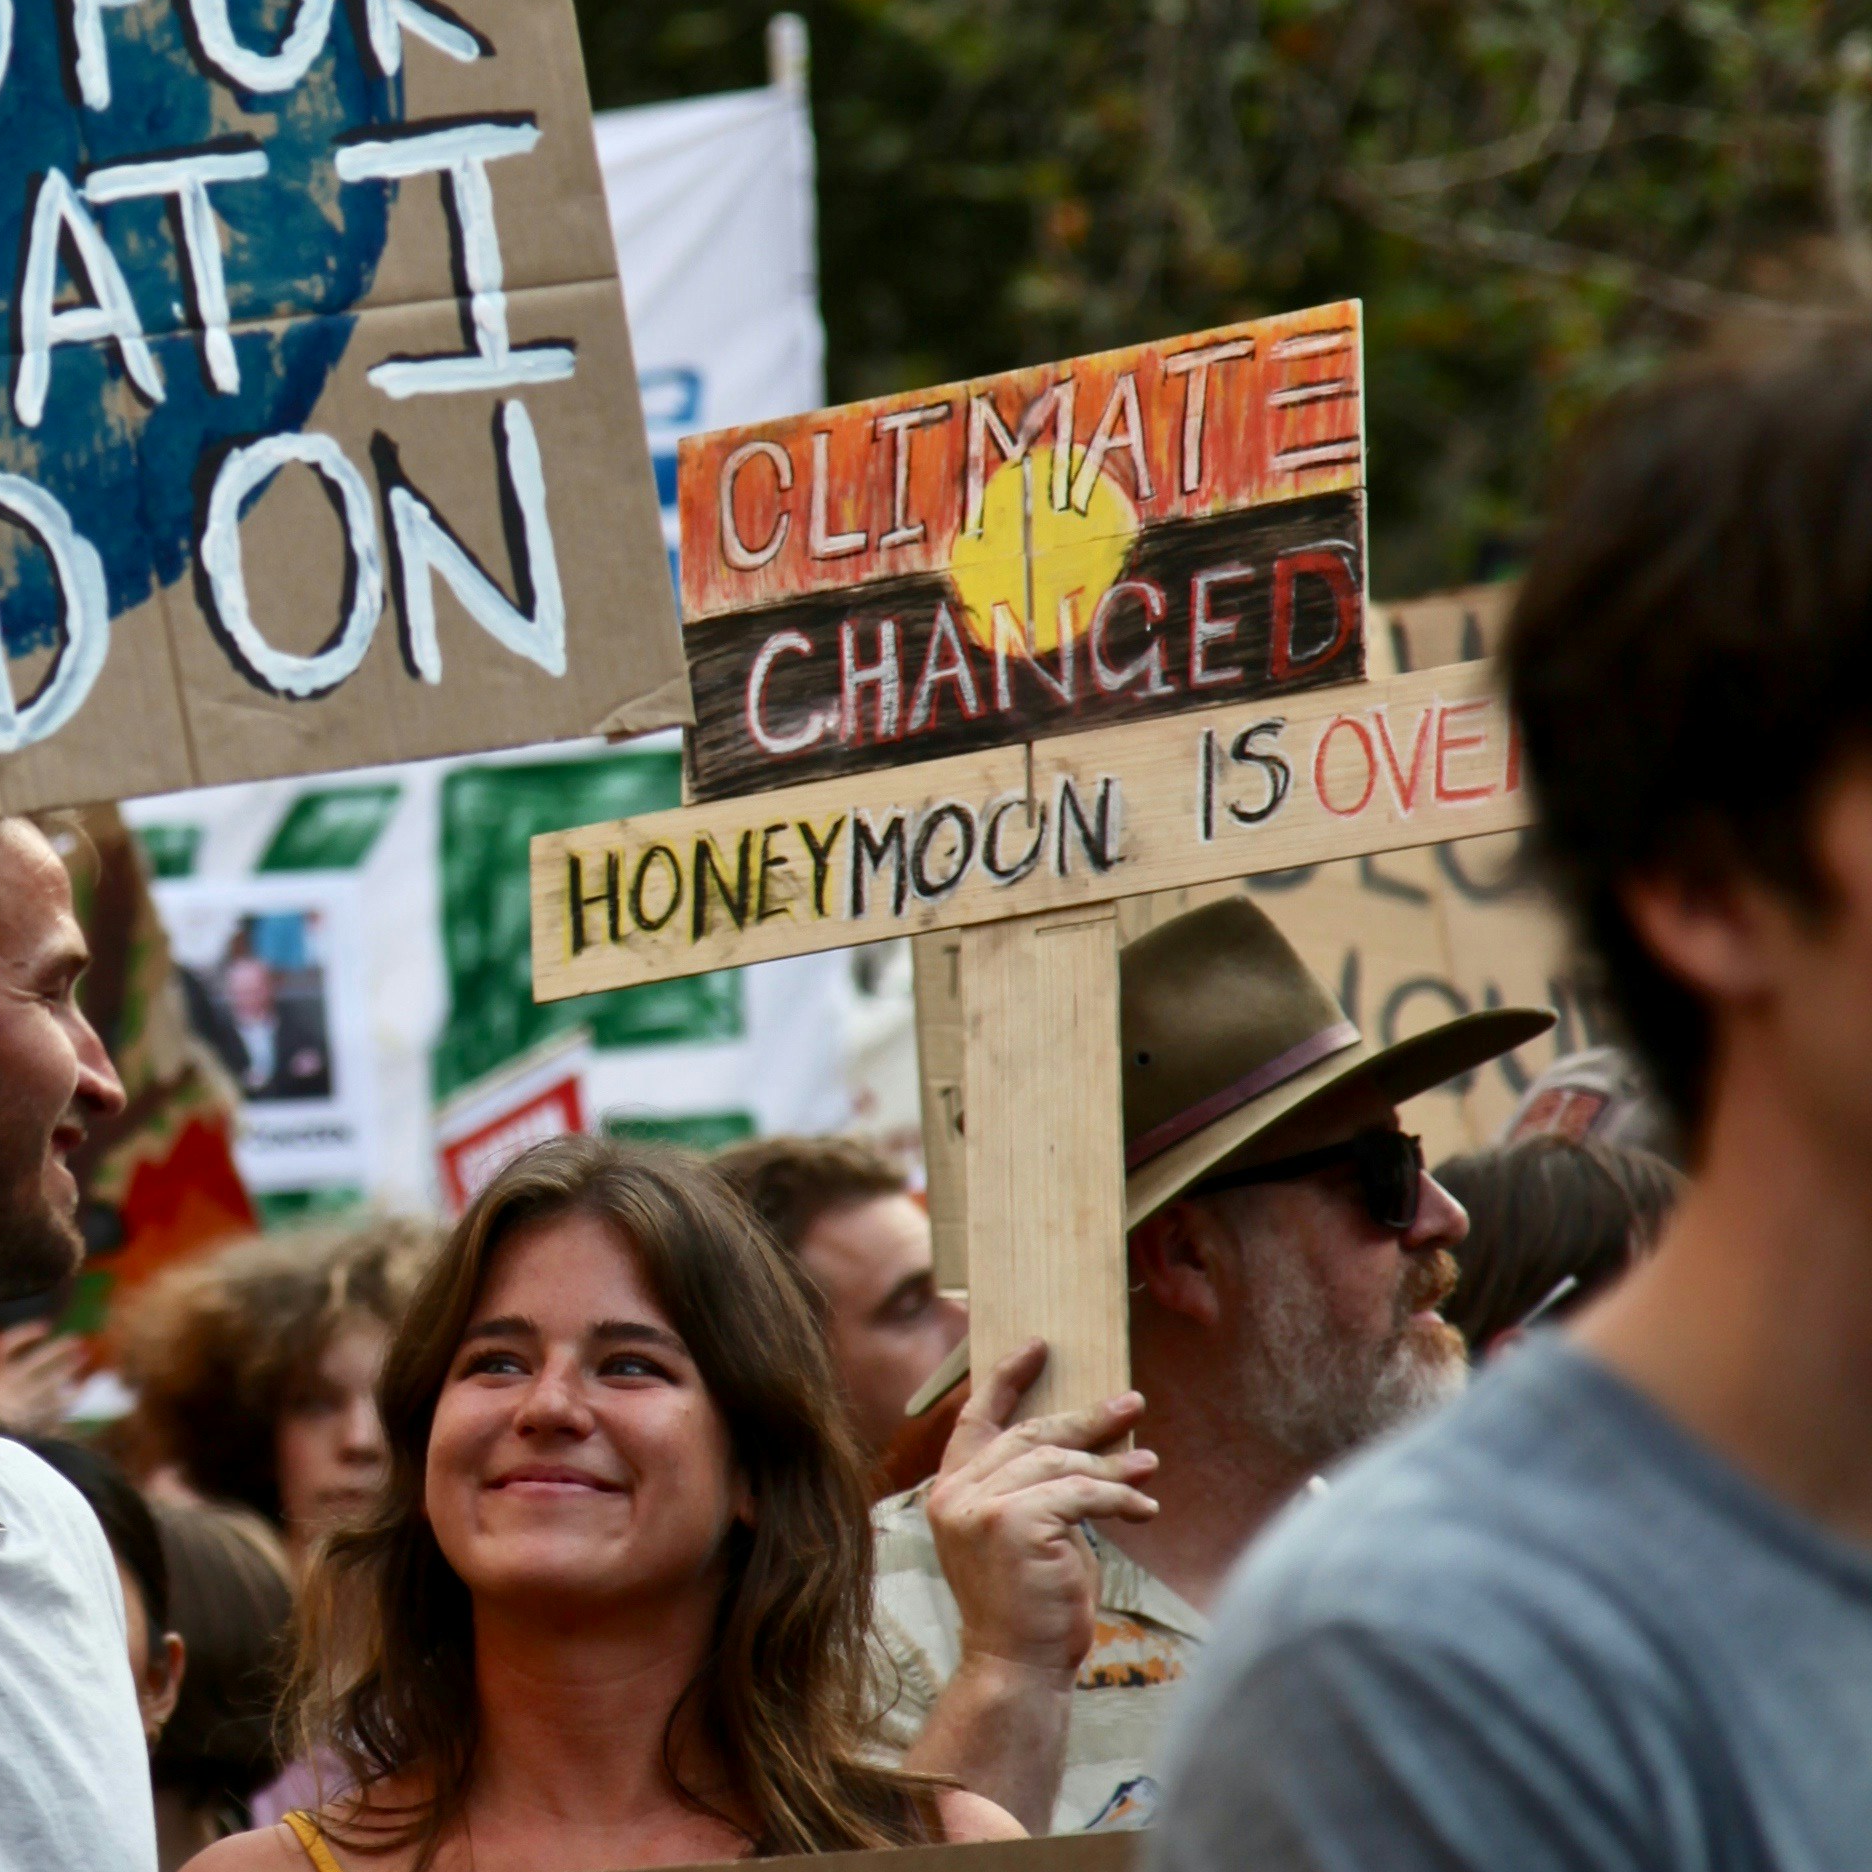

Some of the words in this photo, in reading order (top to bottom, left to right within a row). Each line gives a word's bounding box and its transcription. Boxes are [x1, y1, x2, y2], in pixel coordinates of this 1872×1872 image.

[335, 120, 579, 399] I
[194, 399, 569, 700] ON
[718, 326, 1360, 572] CLIMATE
[744, 538, 1358, 757] CHANGED
[564, 772, 1127, 959] HONEYMOON
[1198, 716, 1291, 843] IS
